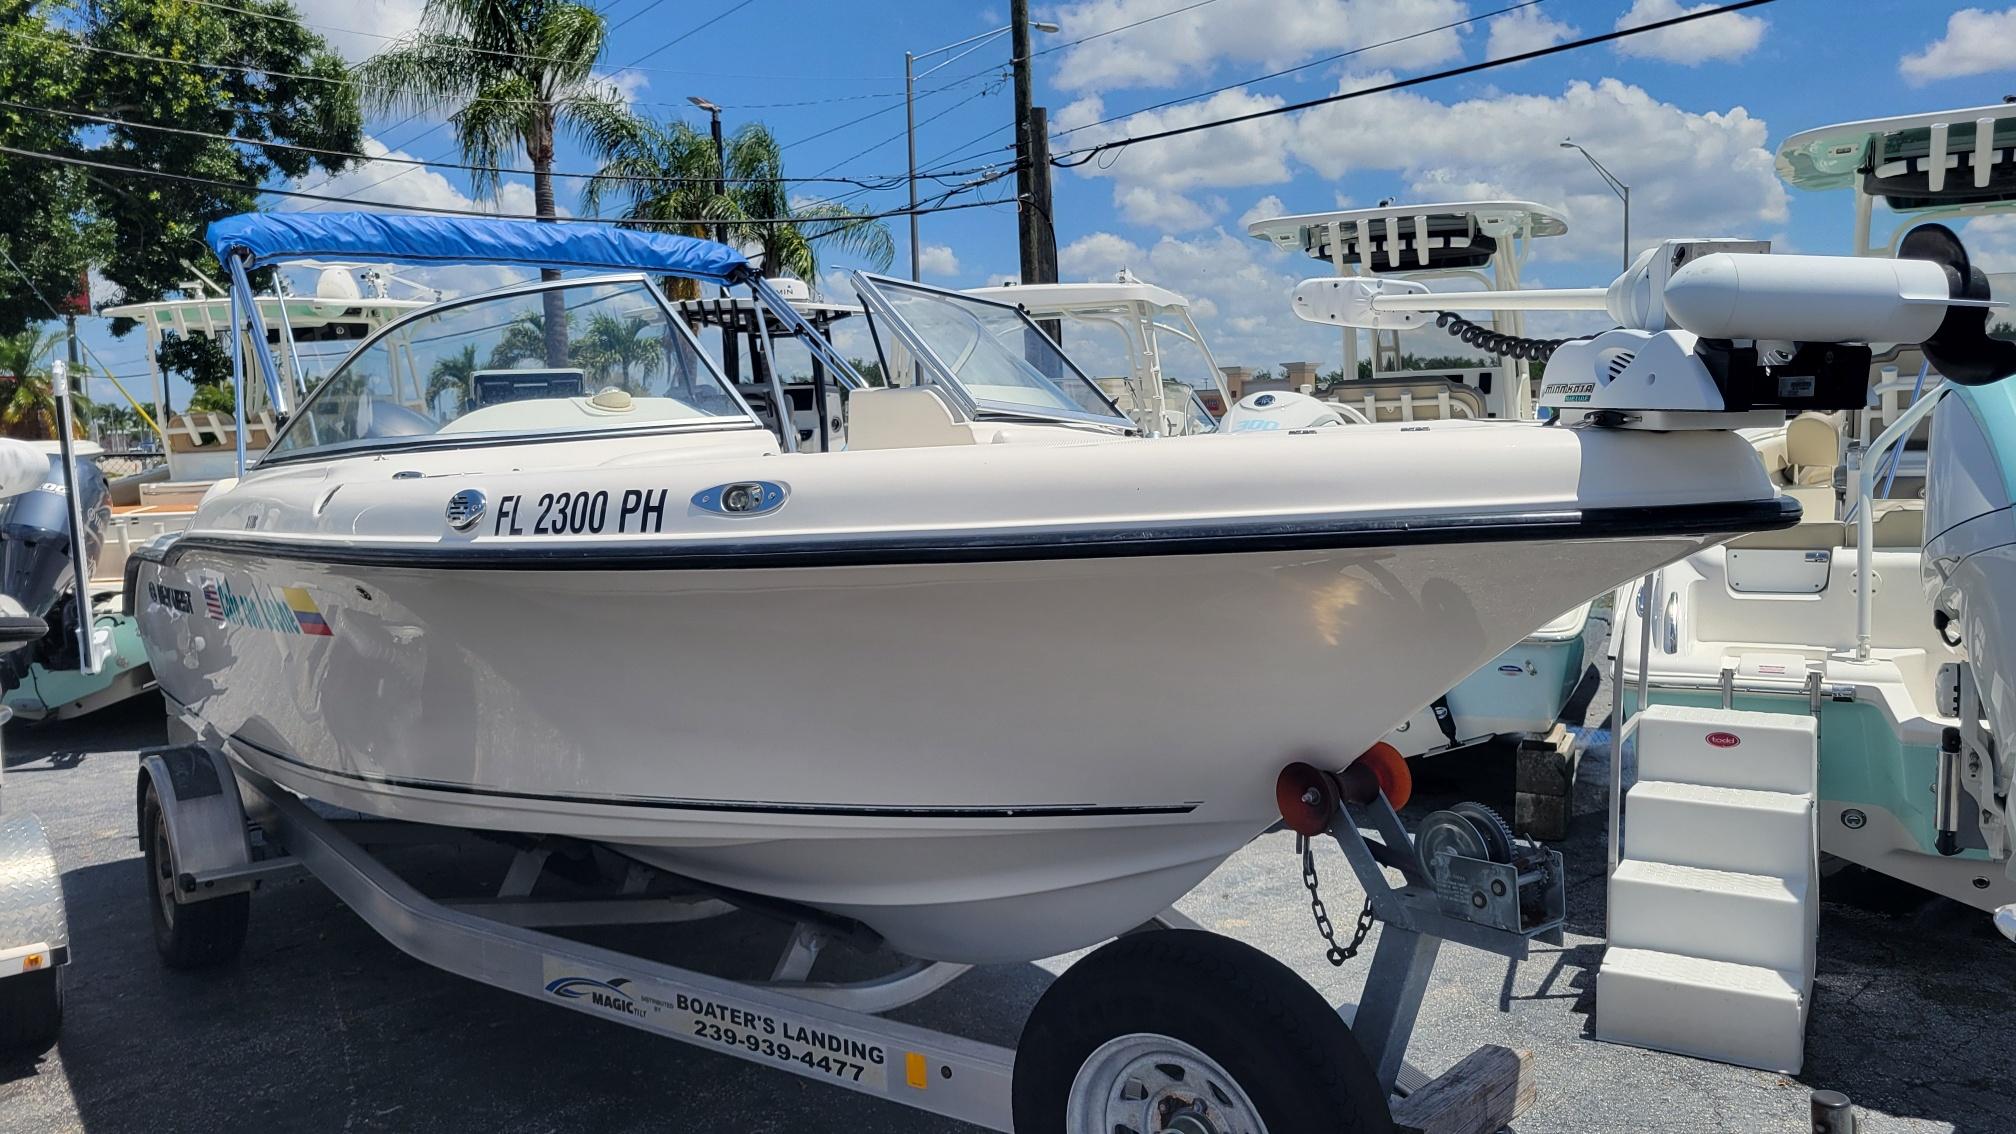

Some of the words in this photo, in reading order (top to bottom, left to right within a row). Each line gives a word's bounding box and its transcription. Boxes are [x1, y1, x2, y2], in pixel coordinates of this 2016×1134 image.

[775, 288, 794, 296] MIN
[494, 495, 523, 536] FL
[533, 490, 609, 535] 2300
[618, 489, 669, 534] PH
[591, 990, 634, 1015] MAGIC
[633, 1008, 648, 1018] TILT
[676, 993, 776, 1035] BOATER'S
[782, 1022, 885, 1065] LANDING
[693, 1020, 865, 1082] 239-939-4477
